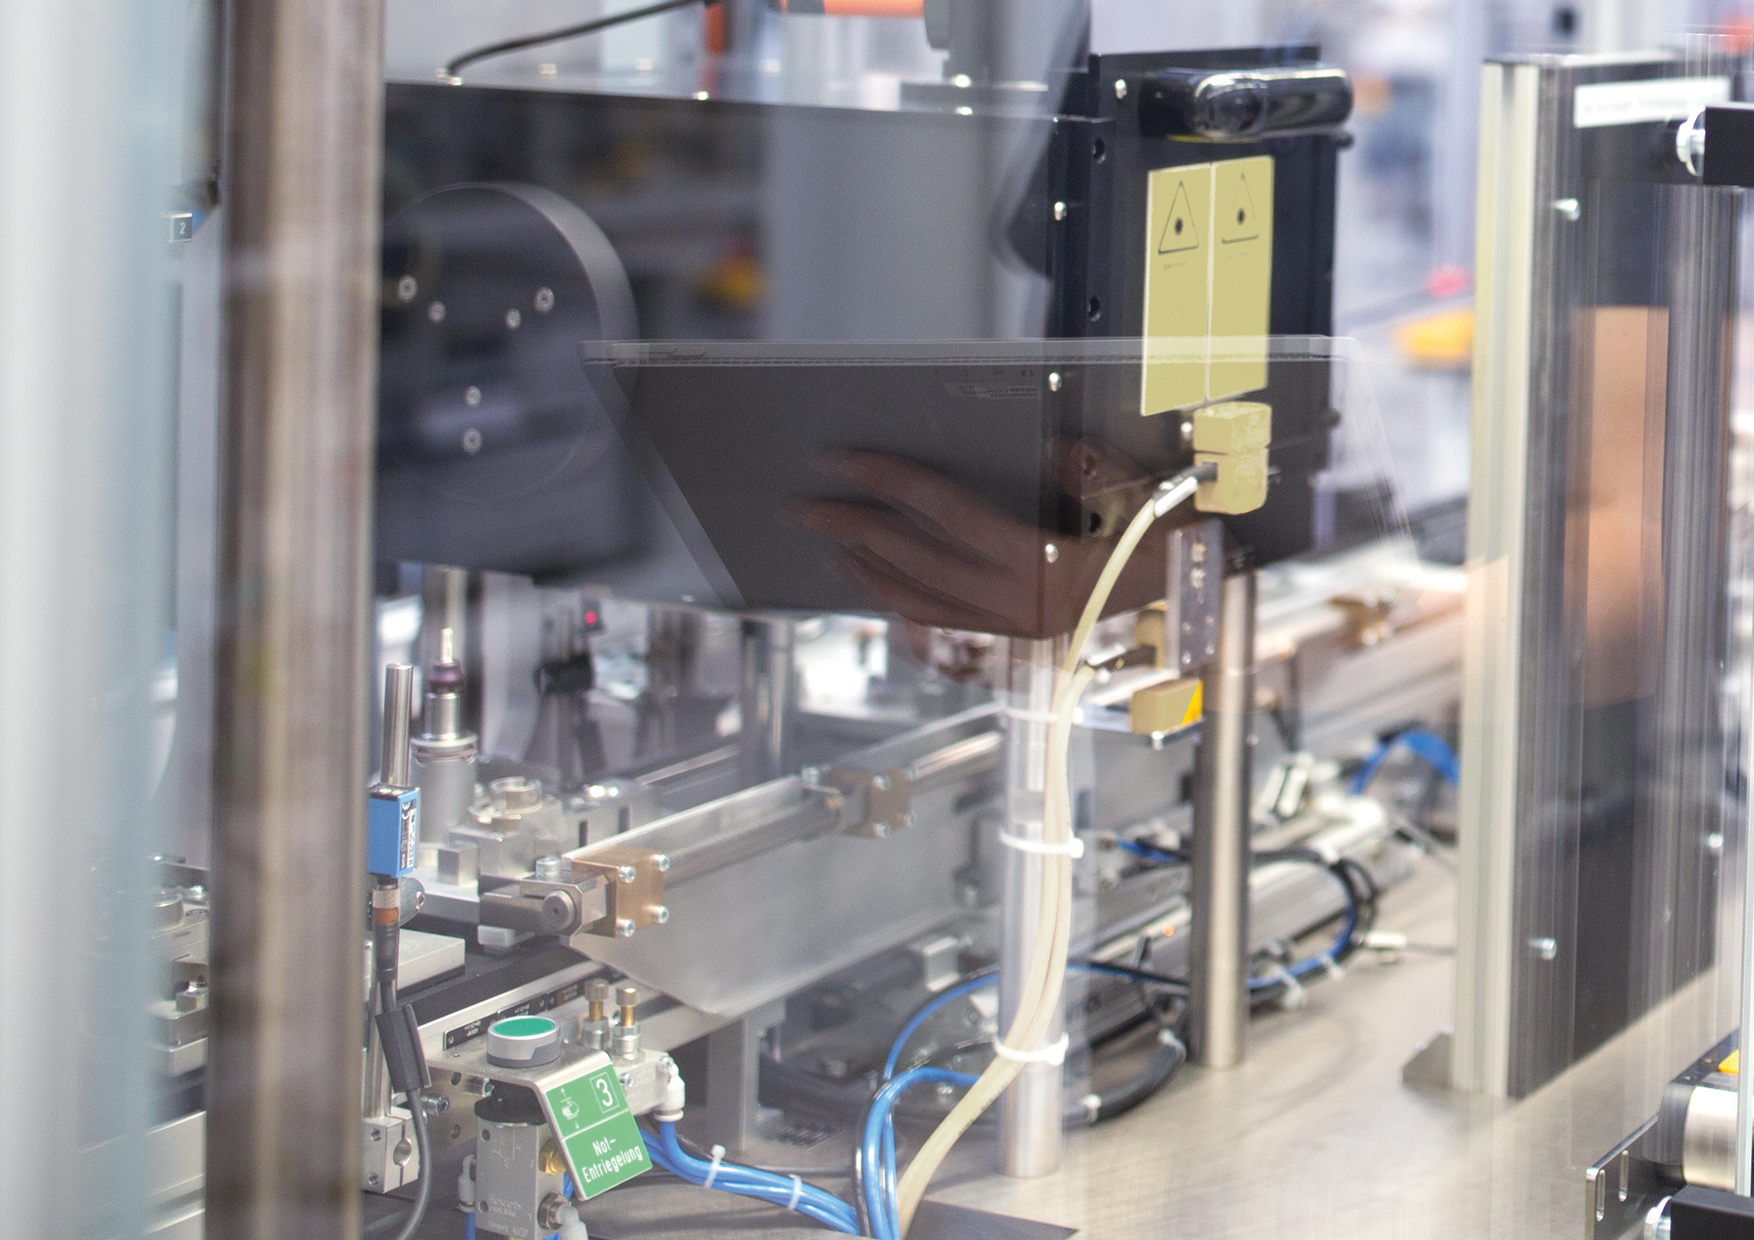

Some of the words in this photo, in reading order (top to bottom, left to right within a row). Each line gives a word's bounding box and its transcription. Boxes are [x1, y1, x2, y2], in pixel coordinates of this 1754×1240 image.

[179, 221, 186, 235] 2
[596, 1078, 613, 1107] 3
[592, 1136, 616, 1156] Not-
[582, 1145, 643, 1183] Entriegelung
